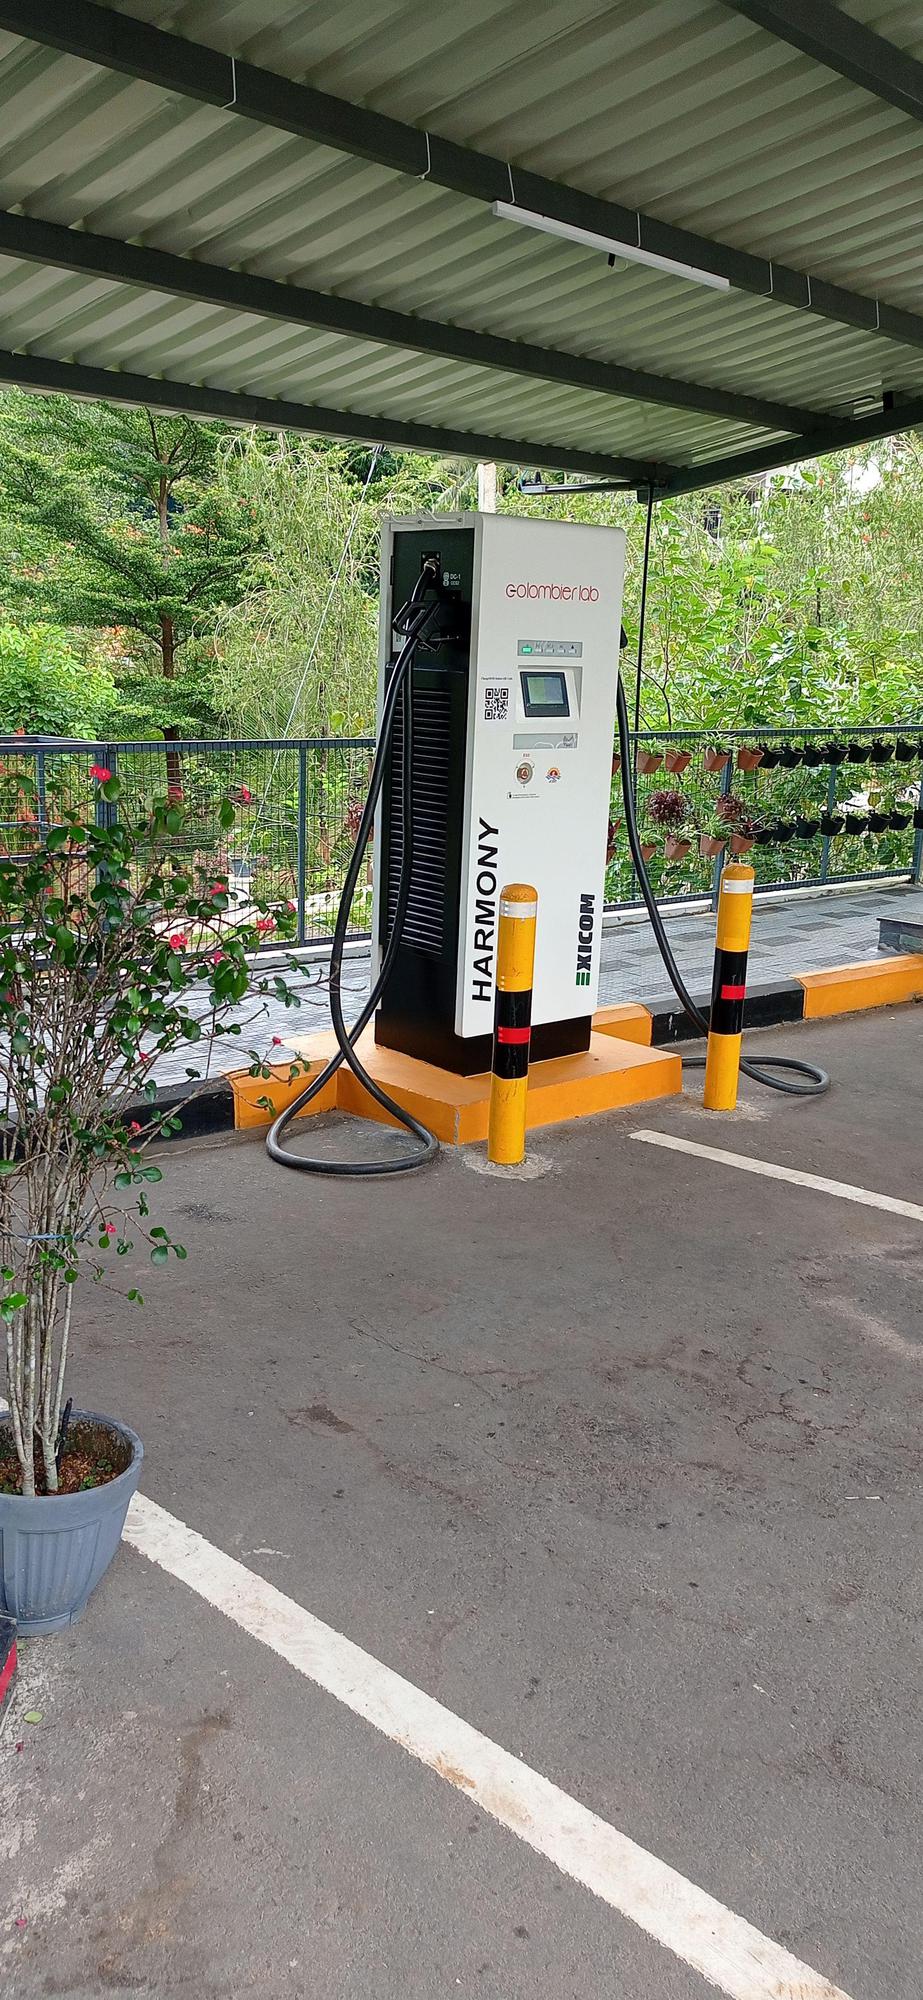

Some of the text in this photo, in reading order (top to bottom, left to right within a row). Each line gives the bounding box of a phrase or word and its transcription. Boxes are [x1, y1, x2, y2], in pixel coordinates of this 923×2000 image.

[579, 585, 599, 601] lab
[472, 817, 499, 1001] HARMONY
[576, 894, 595, 986] EXICOM
